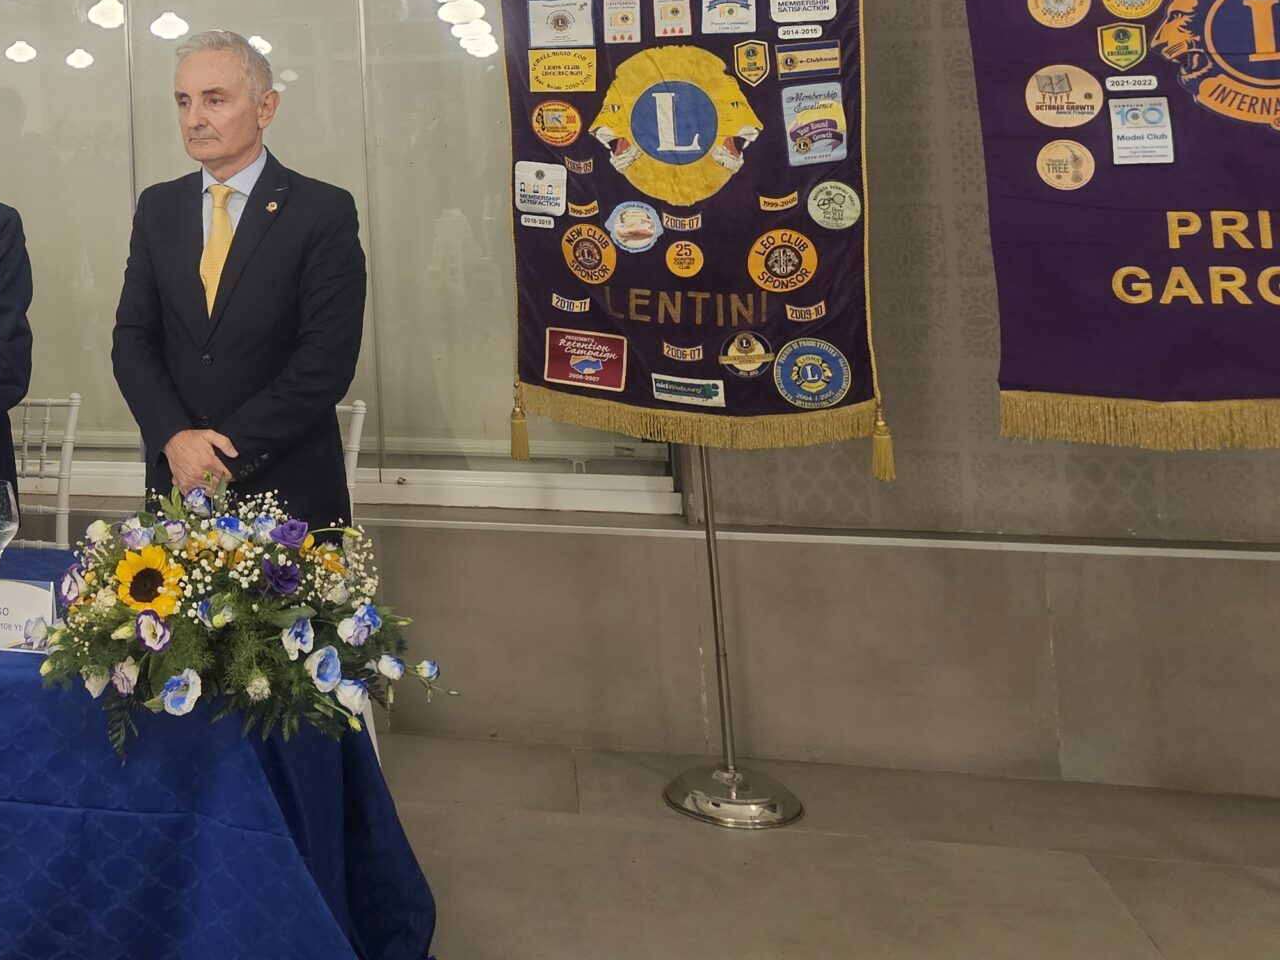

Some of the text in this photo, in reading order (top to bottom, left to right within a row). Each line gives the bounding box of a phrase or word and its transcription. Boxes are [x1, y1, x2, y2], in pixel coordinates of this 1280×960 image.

[777, 0, 829, 7] MEMBERSHIP
[778, 5, 830, 13] SATISFACTION
[799, 56, 839, 64] e-Clubhouse
[1110, 79, 1152, 87] 2021-2022
[786, 90, 838, 103] Membership
[794, 102, 833, 113] Excellence
[651, 92, 701, 152] L
[1115, 108, 1164, 126] 100
[1046, 163, 1070, 173] TREE
[520, 199, 560, 207] SATISFACTION
[763, 197, 797, 207] 1999-2000
[570, 205, 598, 215] 1999-2000
[664, 216, 700, 229] 2006-07
[1167, 210, 1273, 249] PRI
[565, 227, 583, 246] NEW
[587, 228, 609, 250] CLUB
[755, 233, 809, 257] LEO CLUB
[676, 244, 692, 257] 25
[569, 260, 610, 281] SPONSOR
[757, 268, 811, 289] SPONSOR
[555, 297, 587, 312] 2010-11
[604, 285, 768, 327] LENTINI
[790, 307, 823, 320] 2009-10
[558, 338, 611, 352] Retention
[564, 346, 618, 362] Campaign
[666, 345, 701, 359] 2006-07
[805, 365, 818, 380] L
